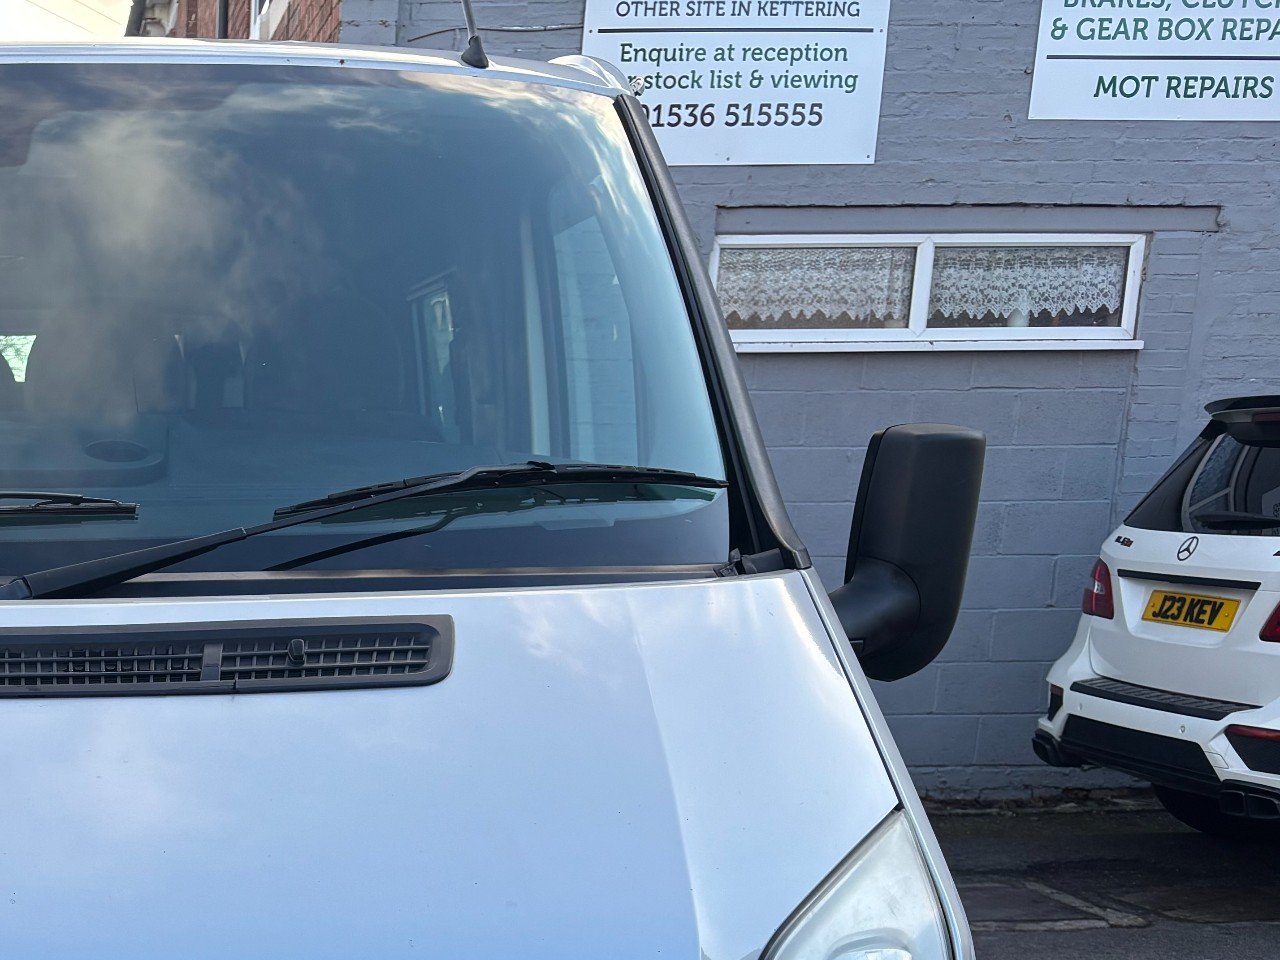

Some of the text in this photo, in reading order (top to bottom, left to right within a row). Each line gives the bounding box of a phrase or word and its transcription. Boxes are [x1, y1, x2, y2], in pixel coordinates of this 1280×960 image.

[616, 1, 860, 17] OTHER SITE IN KETTERING
[1050, 17, 1068, 41] &
[1076, 17, 1149, 41] GEAR
[1157, 17, 1214, 41] BOX
[620, 42, 848, 67] Enquire at reception
[644, 70, 703, 90] stock
[710, 69, 742, 89] list
[749, 69, 764, 89] &
[770, 69, 859, 94] viewing
[1093, 75, 1275, 99] MOT REPAIRS
[724, 103, 823, 127] 515555
[1151, 595, 1224, 626] J23 KEV
